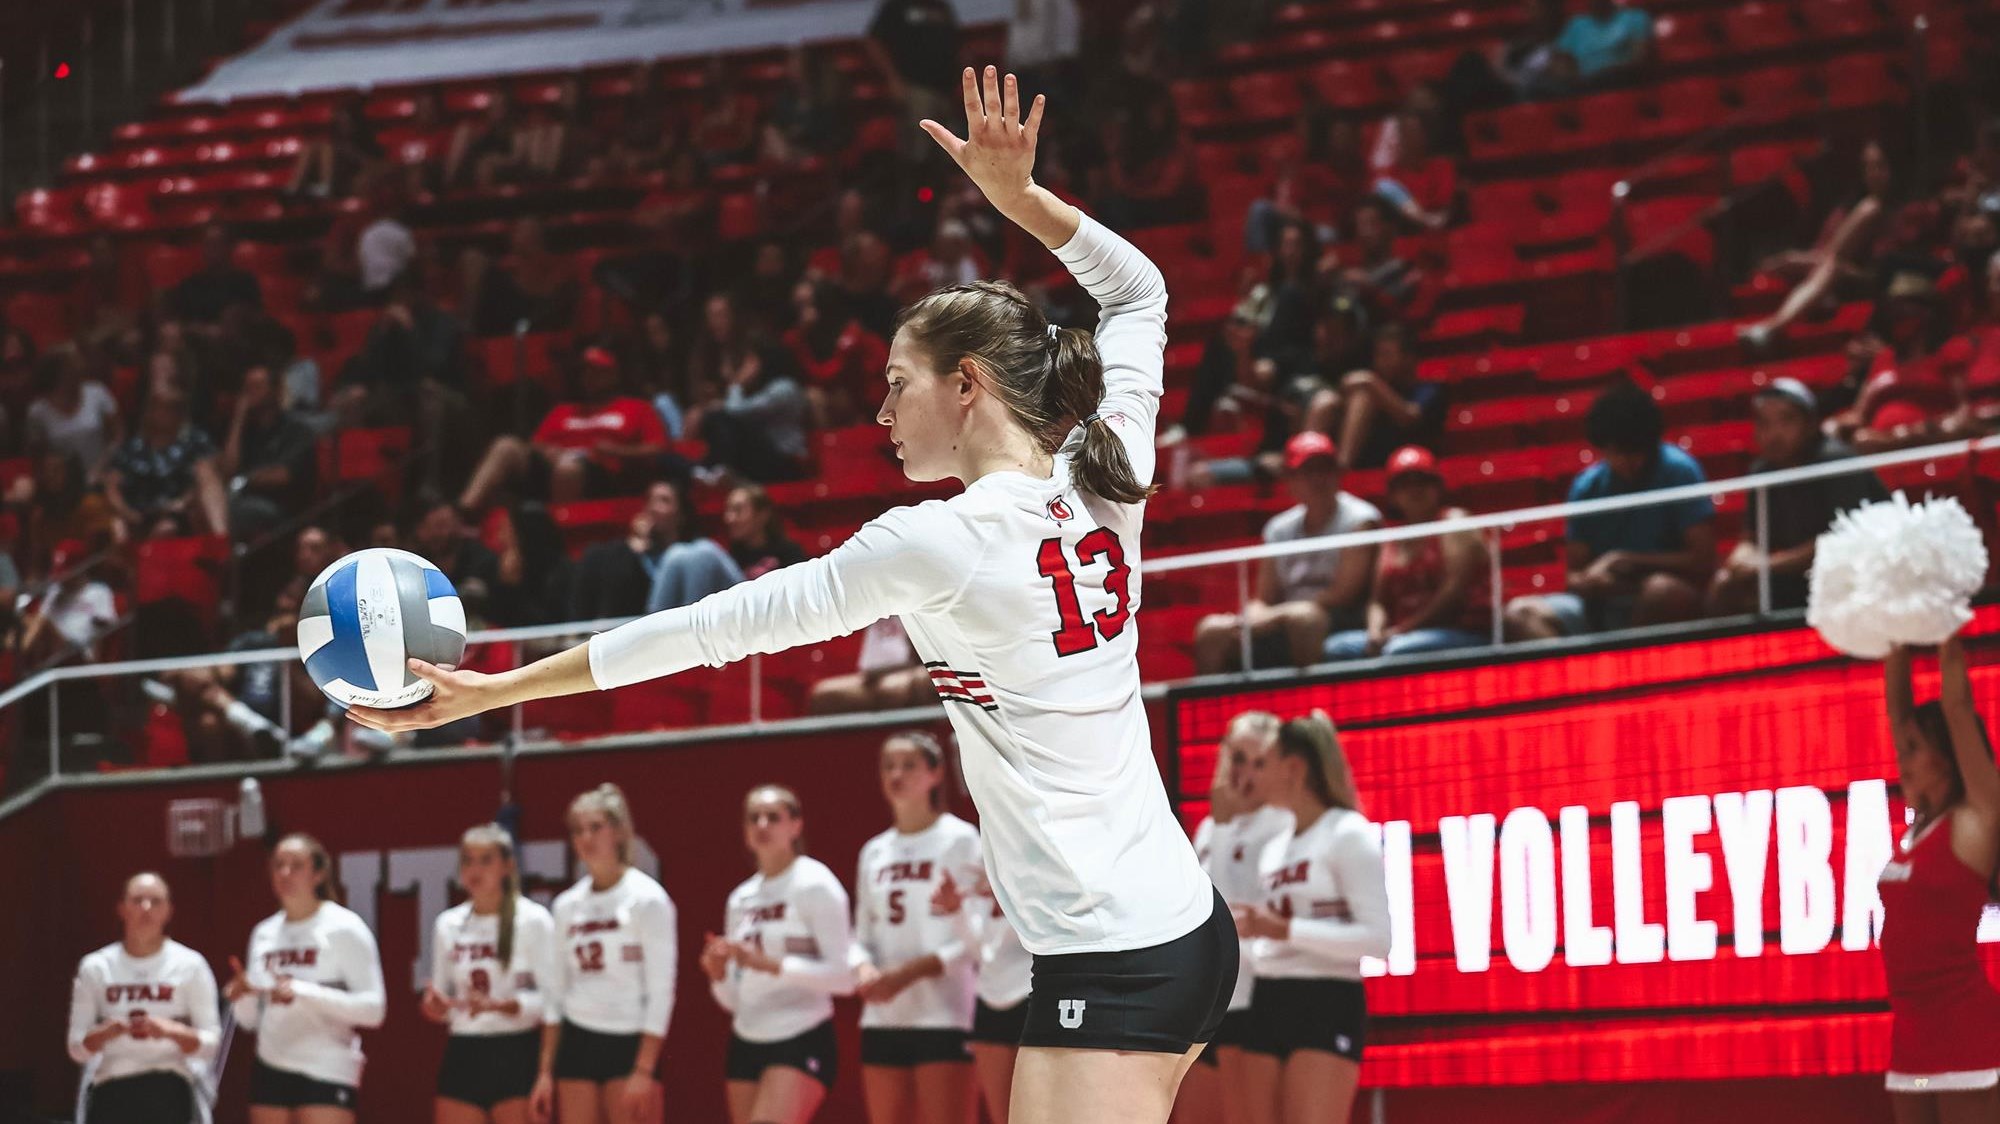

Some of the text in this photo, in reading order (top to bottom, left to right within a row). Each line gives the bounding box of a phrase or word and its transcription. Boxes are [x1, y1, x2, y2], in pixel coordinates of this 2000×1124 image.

[1037, 526, 1131, 657] 13
[1440, 778, 1893, 973] VOLLEYBA
[575, 941, 605, 972] 12
[106, 984, 175, 1003] UTAH
[1058, 999, 1086, 1029] U
